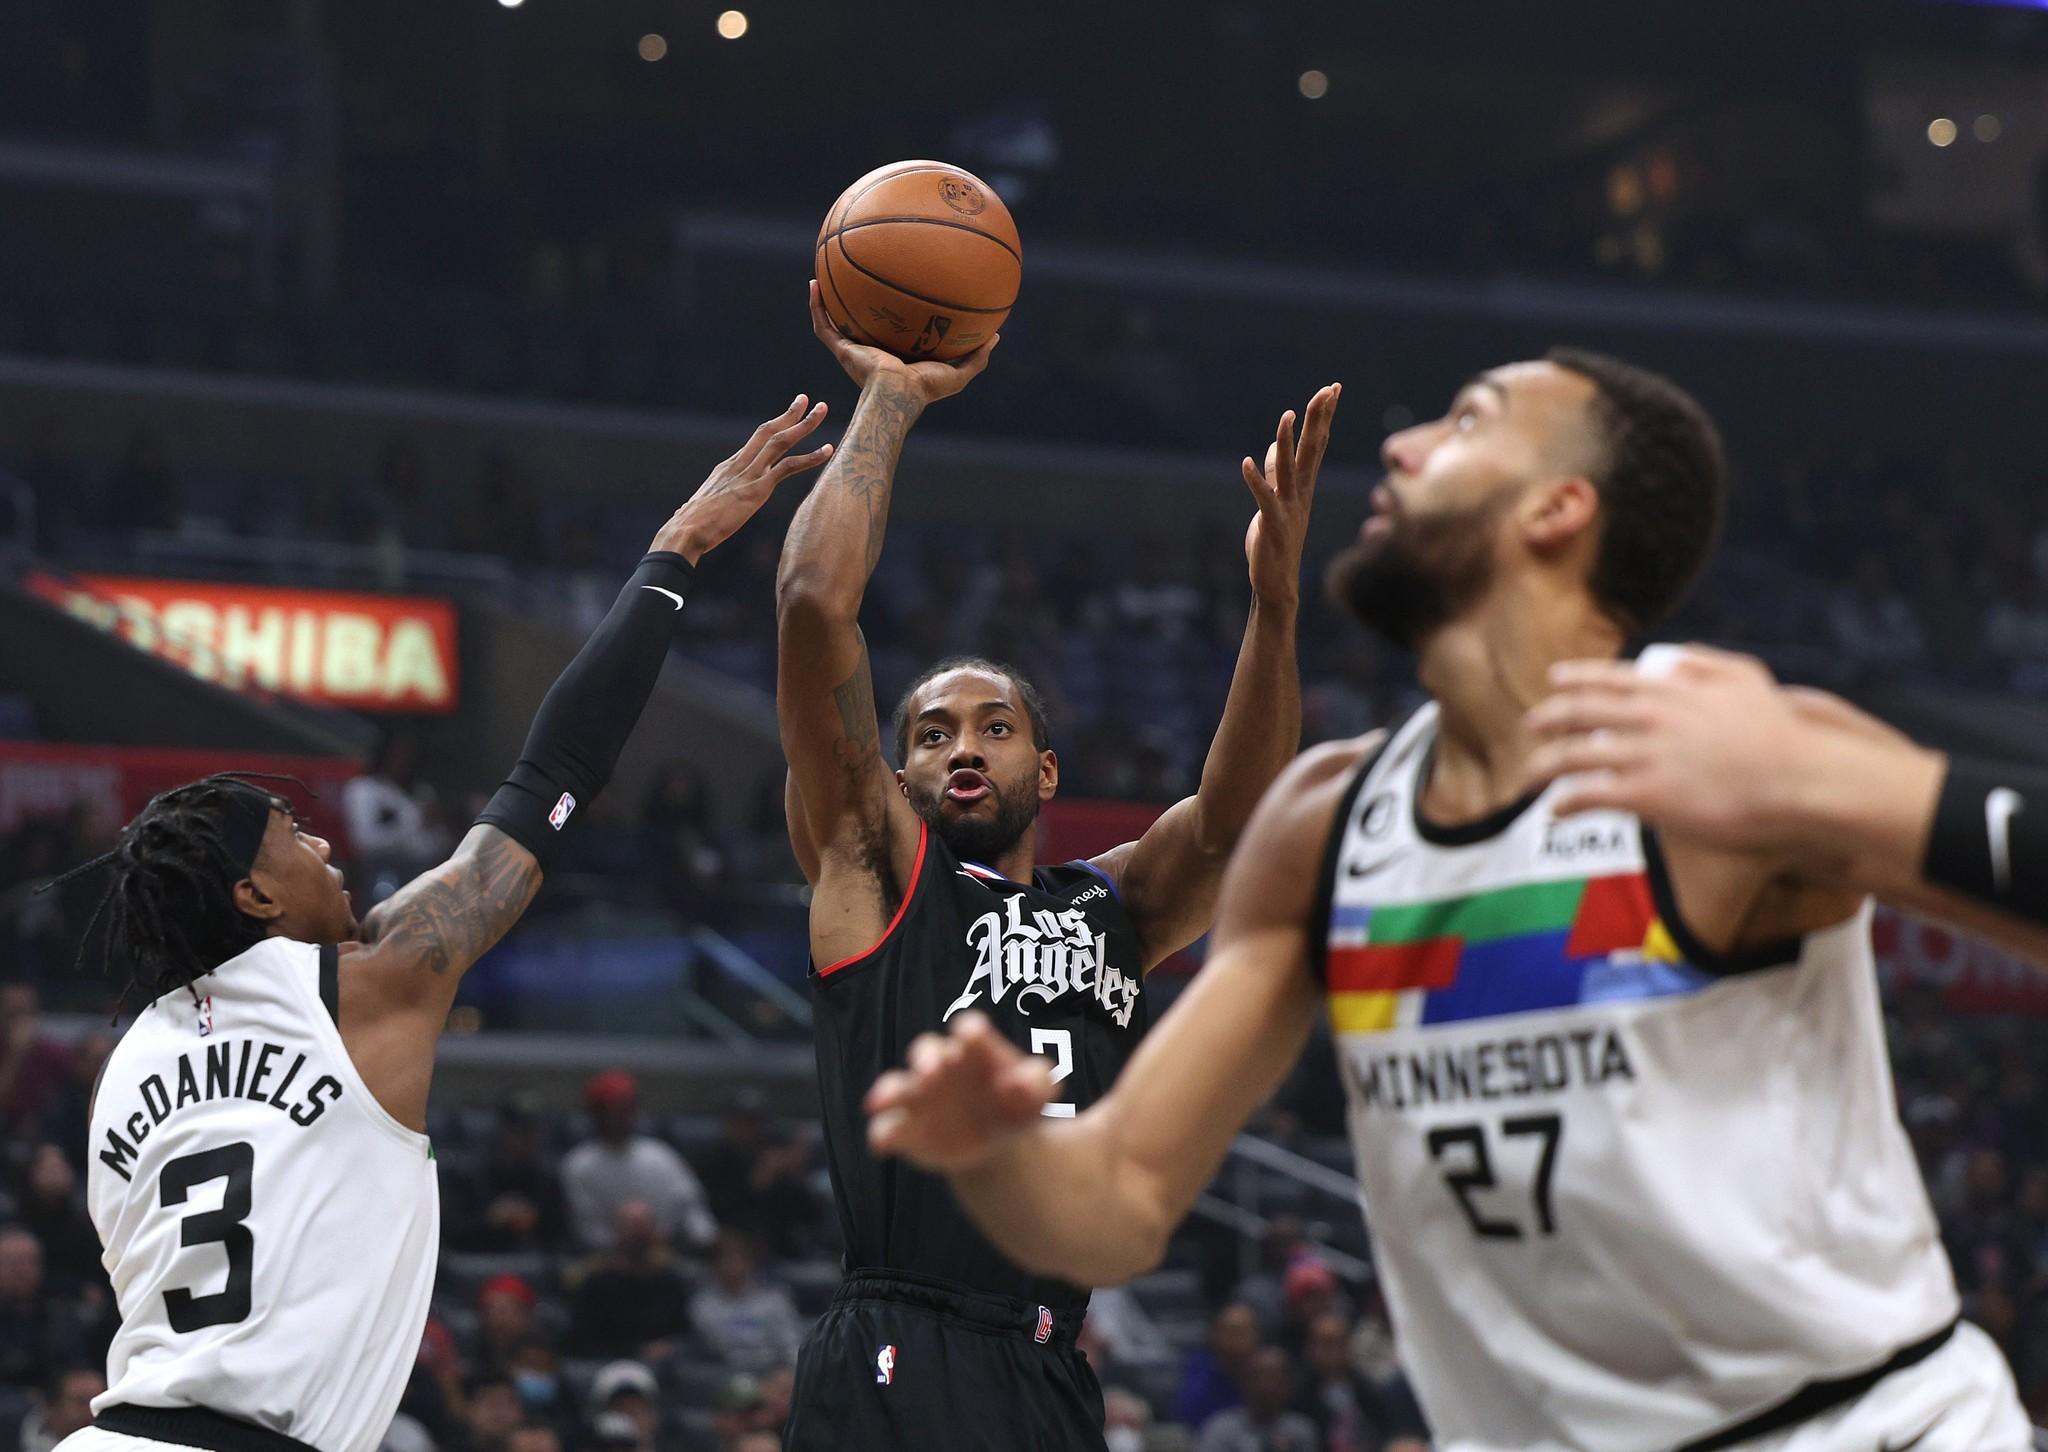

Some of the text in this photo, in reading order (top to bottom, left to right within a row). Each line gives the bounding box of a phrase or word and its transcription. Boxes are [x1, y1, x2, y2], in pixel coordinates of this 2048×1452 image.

[942, 911, 1140, 1029] Angeles
[1002, 893, 1095, 948] Los
[99, 1040, 343, 1182] McDANIELS
[1350, 1026, 1634, 1107] MINNESOTA
[1428, 1114, 1561, 1239] 27
[160, 1141, 255, 1334] 3
